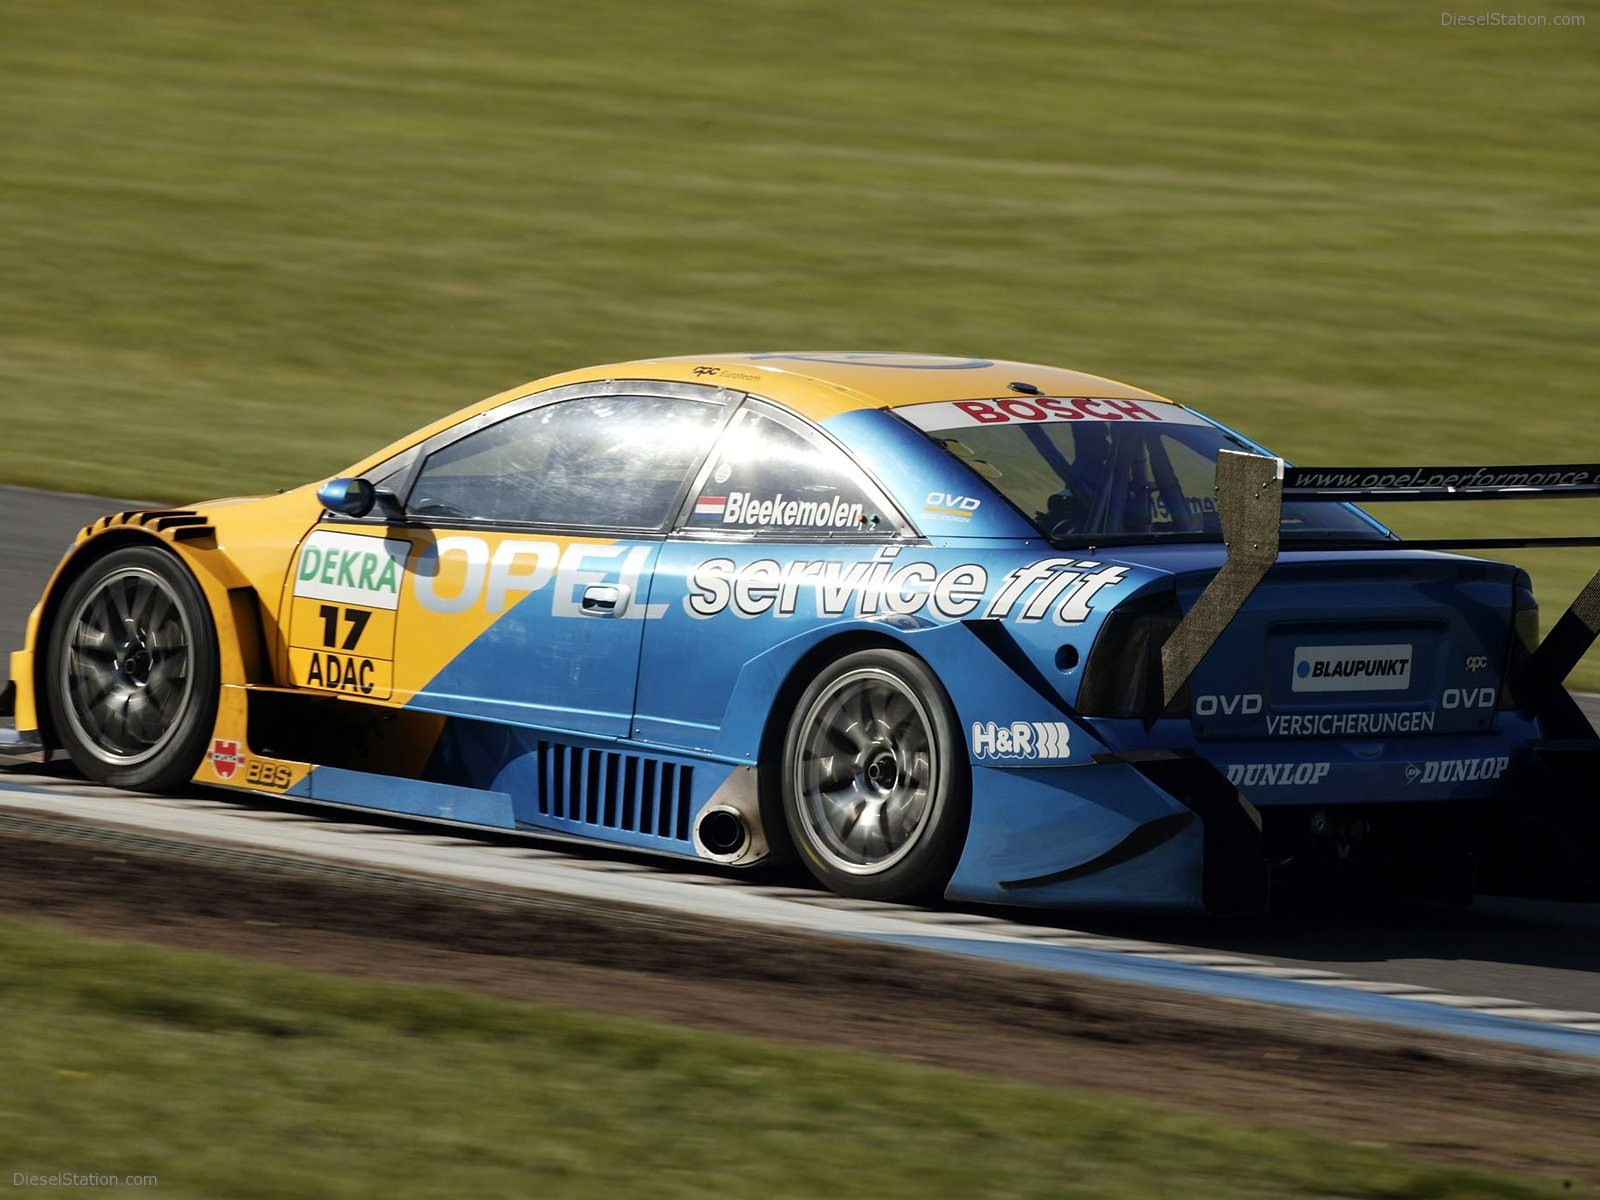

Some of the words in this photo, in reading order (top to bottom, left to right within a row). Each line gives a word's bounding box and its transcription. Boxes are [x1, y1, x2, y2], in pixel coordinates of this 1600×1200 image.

[952, 397, 1163, 424] BOSCH
[723, 492, 864, 527] Bleekemolen
[926, 492, 981, 511] OVD
[299, 545, 397, 594] DEKRA
[414, 535, 670, 619] OPEL
[684, 546, 988, 619] service
[989, 557, 1131, 625] fit
[319, 605, 372, 650] 17
[307, 653, 375, 694] ADAC
[1312, 658, 1409, 677] BLAUPUNKT
[1196, 694, 1263, 715] OVD
[1442, 688, 1496, 709] OVD
[1266, 711, 1436, 735] VERSICHERUNGEN
[246, 760, 292, 789] BBS
[1227, 762, 1331, 785] DUNLOP
[1420, 757, 1510, 783] DUNLOP
